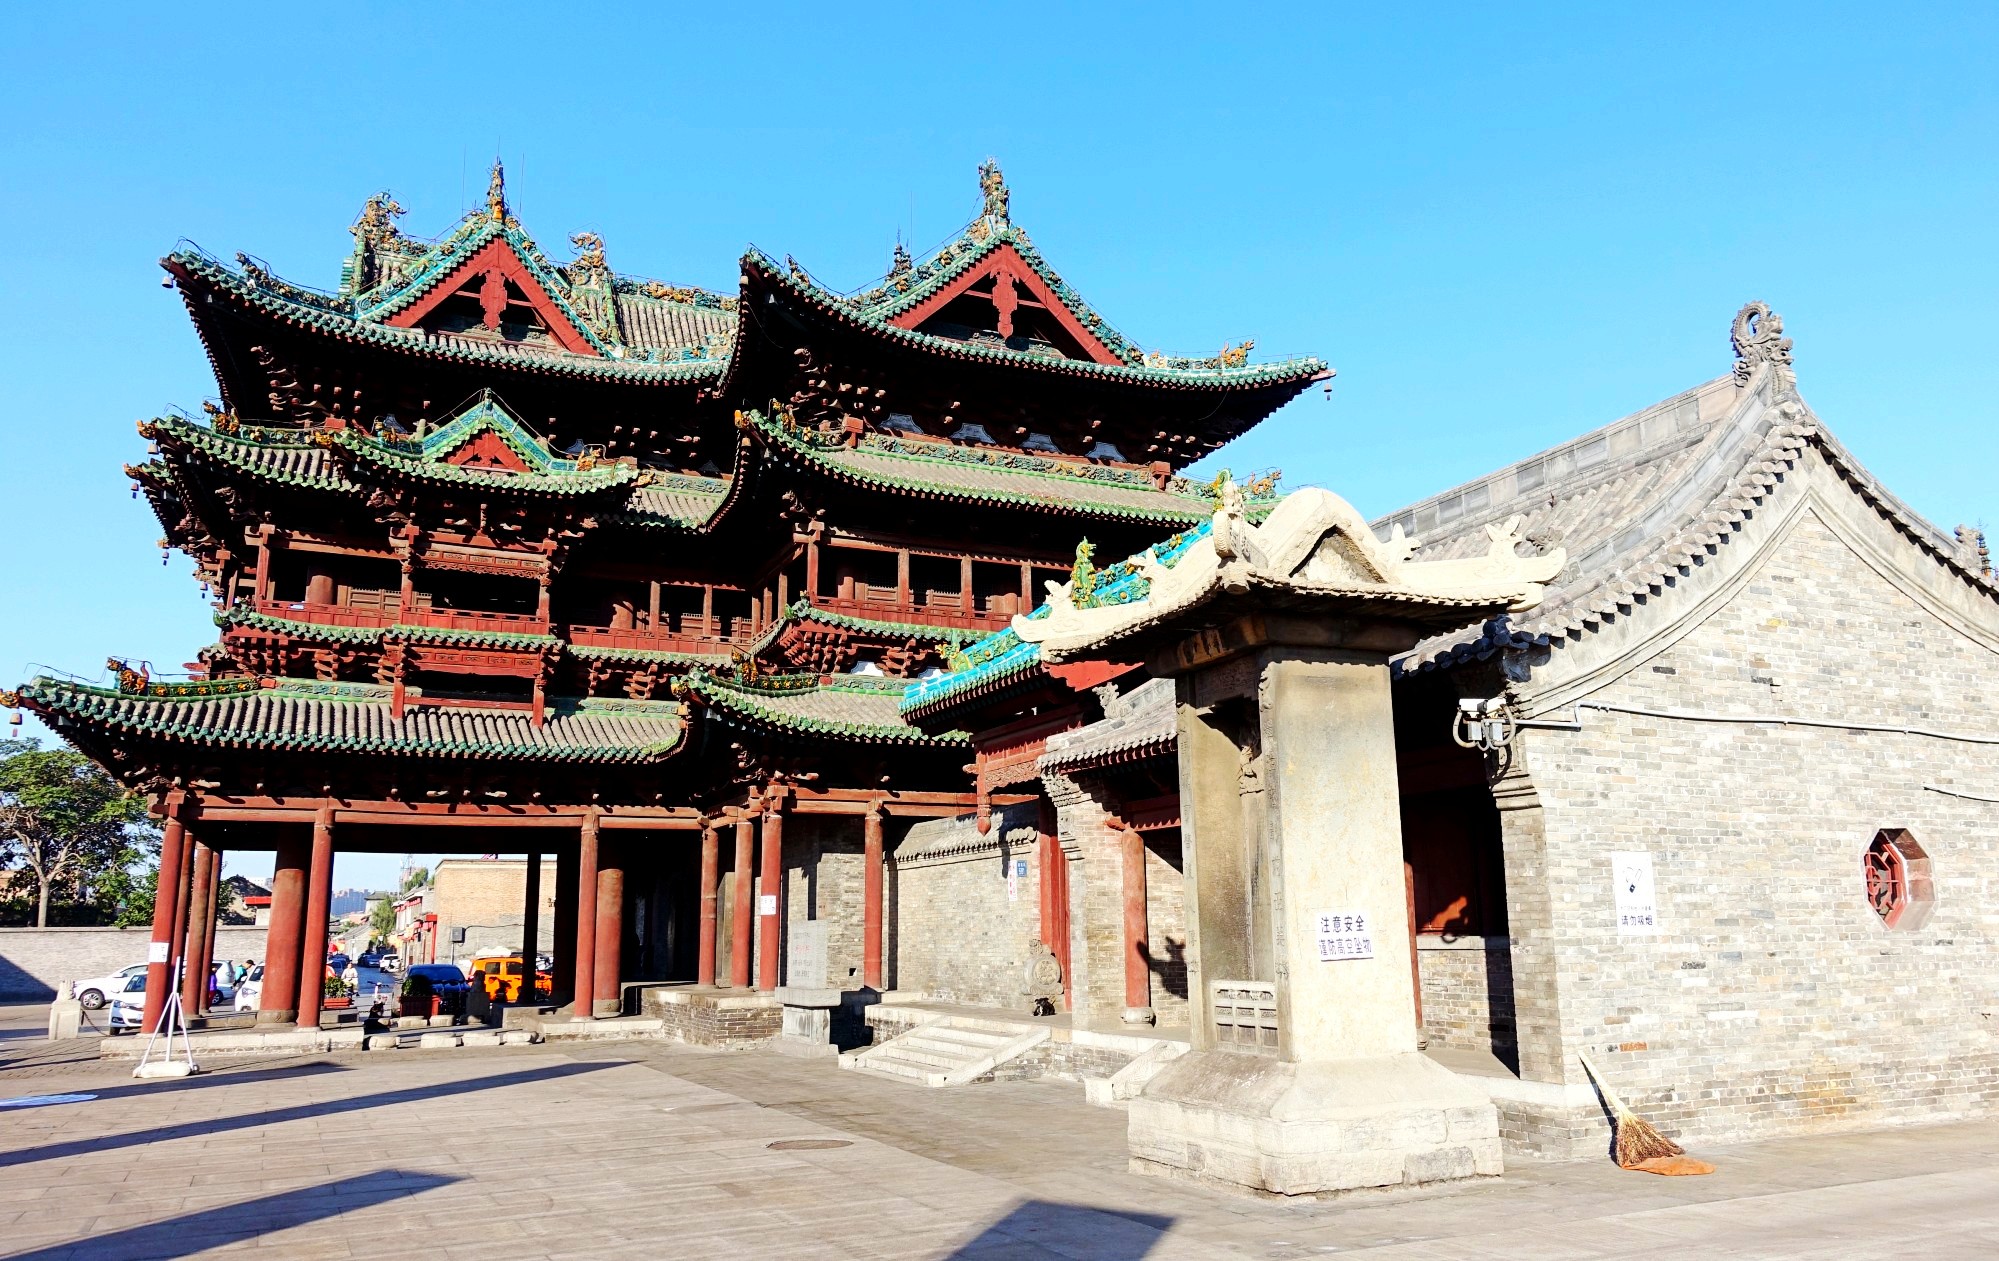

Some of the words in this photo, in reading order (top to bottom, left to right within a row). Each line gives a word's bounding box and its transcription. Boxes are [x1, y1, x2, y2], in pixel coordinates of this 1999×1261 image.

[1320, 914, 1365, 933] 注意安全
[1621, 914, 1653, 927] 请勿吸烟
